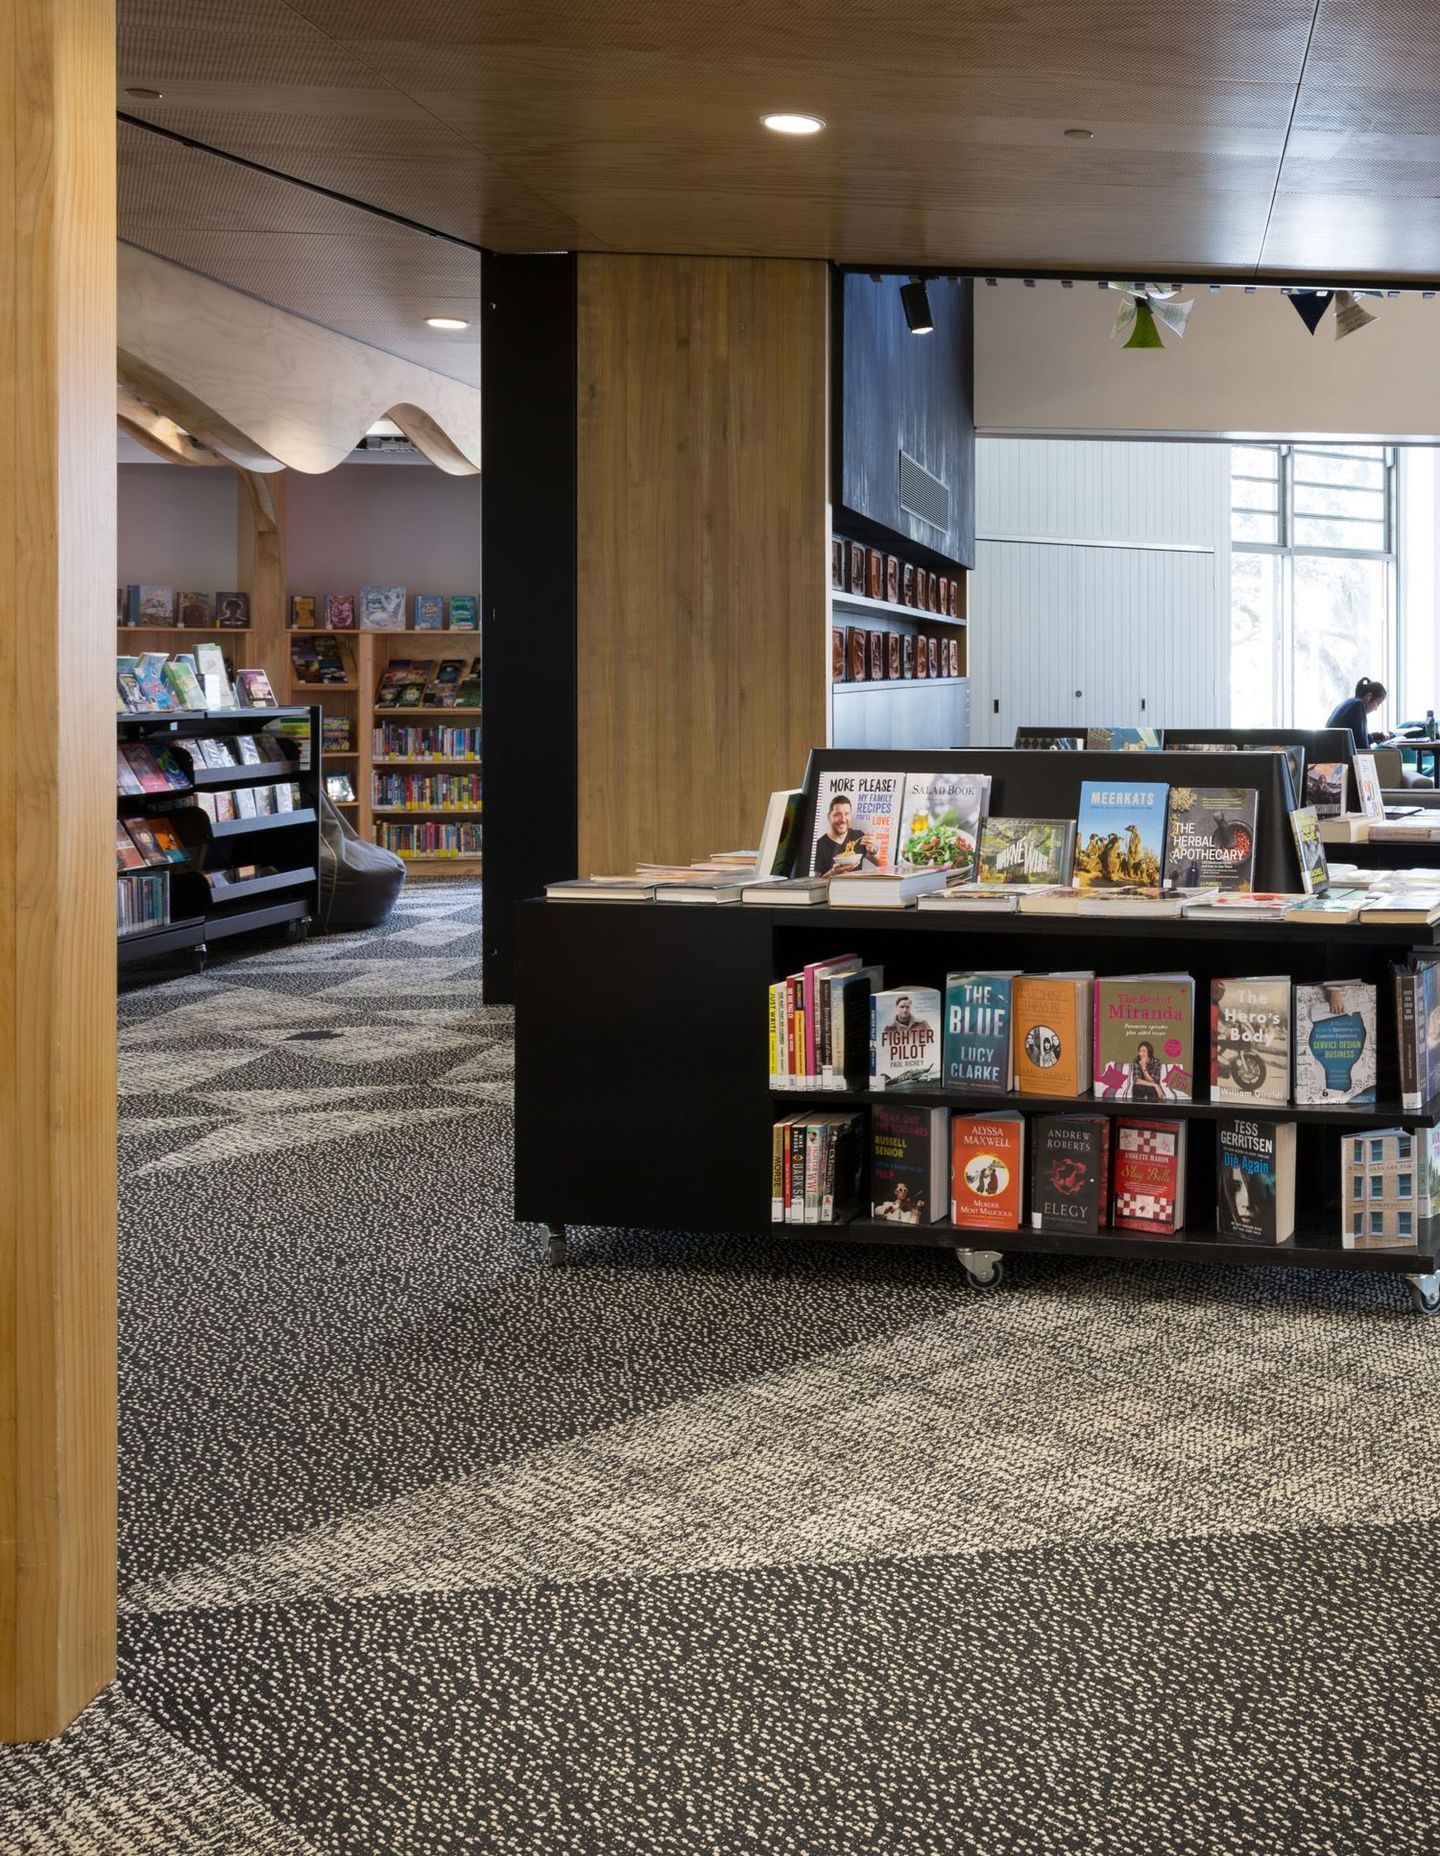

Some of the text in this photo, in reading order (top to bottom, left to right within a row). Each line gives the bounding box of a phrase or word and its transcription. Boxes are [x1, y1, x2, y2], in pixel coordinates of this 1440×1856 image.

[830, 778, 896, 792] MORE PLEASE!
[912, 784, 975, 796] SALAD BOOK
[858, 794, 893, 803] MY FAMILY
[1091, 791, 1155, 806] MEERKATS
[857, 803, 892, 814] RECIPES
[872, 816, 890, 826] LOVE
[1175, 822, 1196, 834] THE
[1173, 835, 1216, 847] HERBAL
[1172, 848, 1245, 862] APOTHECARY
[964, 985, 992, 1005] THE
[1237, 990, 1269, 1005] The
[1108, 1003, 1184, 1020] Miranda
[1224, 1008, 1281, 1025] Hero's
[949, 1005, 1006, 1038] BLUE
[881, 1029, 935, 1047] FIGHTER
[1230, 1027, 1275, 1047] Body
[1312, 1040, 1362, 1049] SERVICE DESIGN
[890, 1044, 926, 1061] PILOT
[960, 1046, 995, 1063] LUCY
[1324, 1050, 1355, 1059] BUSINESS
[950, 1062, 1001, 1082] CLARKE
[1220, 1087, 1252, 1097] William
[971, 1126, 1004, 1136] ALYSSA
[1234, 1119, 1259, 1136] TESS
[875, 1135, 908, 1148] RUSSELL
[963, 1135, 1012, 1148] MAXWELL
[1048, 1129, 1092, 1141] ANDREW
[1220, 1130, 1273, 1154] GERRITSEN
[1047, 1139, 1092, 1151] ROBERTS
[875, 1147, 905, 1159] SENIOR
[1224, 1151, 1269, 1175] Die Again
[774, 1156, 783, 1188] MORSE
[960, 1205, 979, 1214] MOST
[1044, 1202, 1089, 1218] ELEGY
